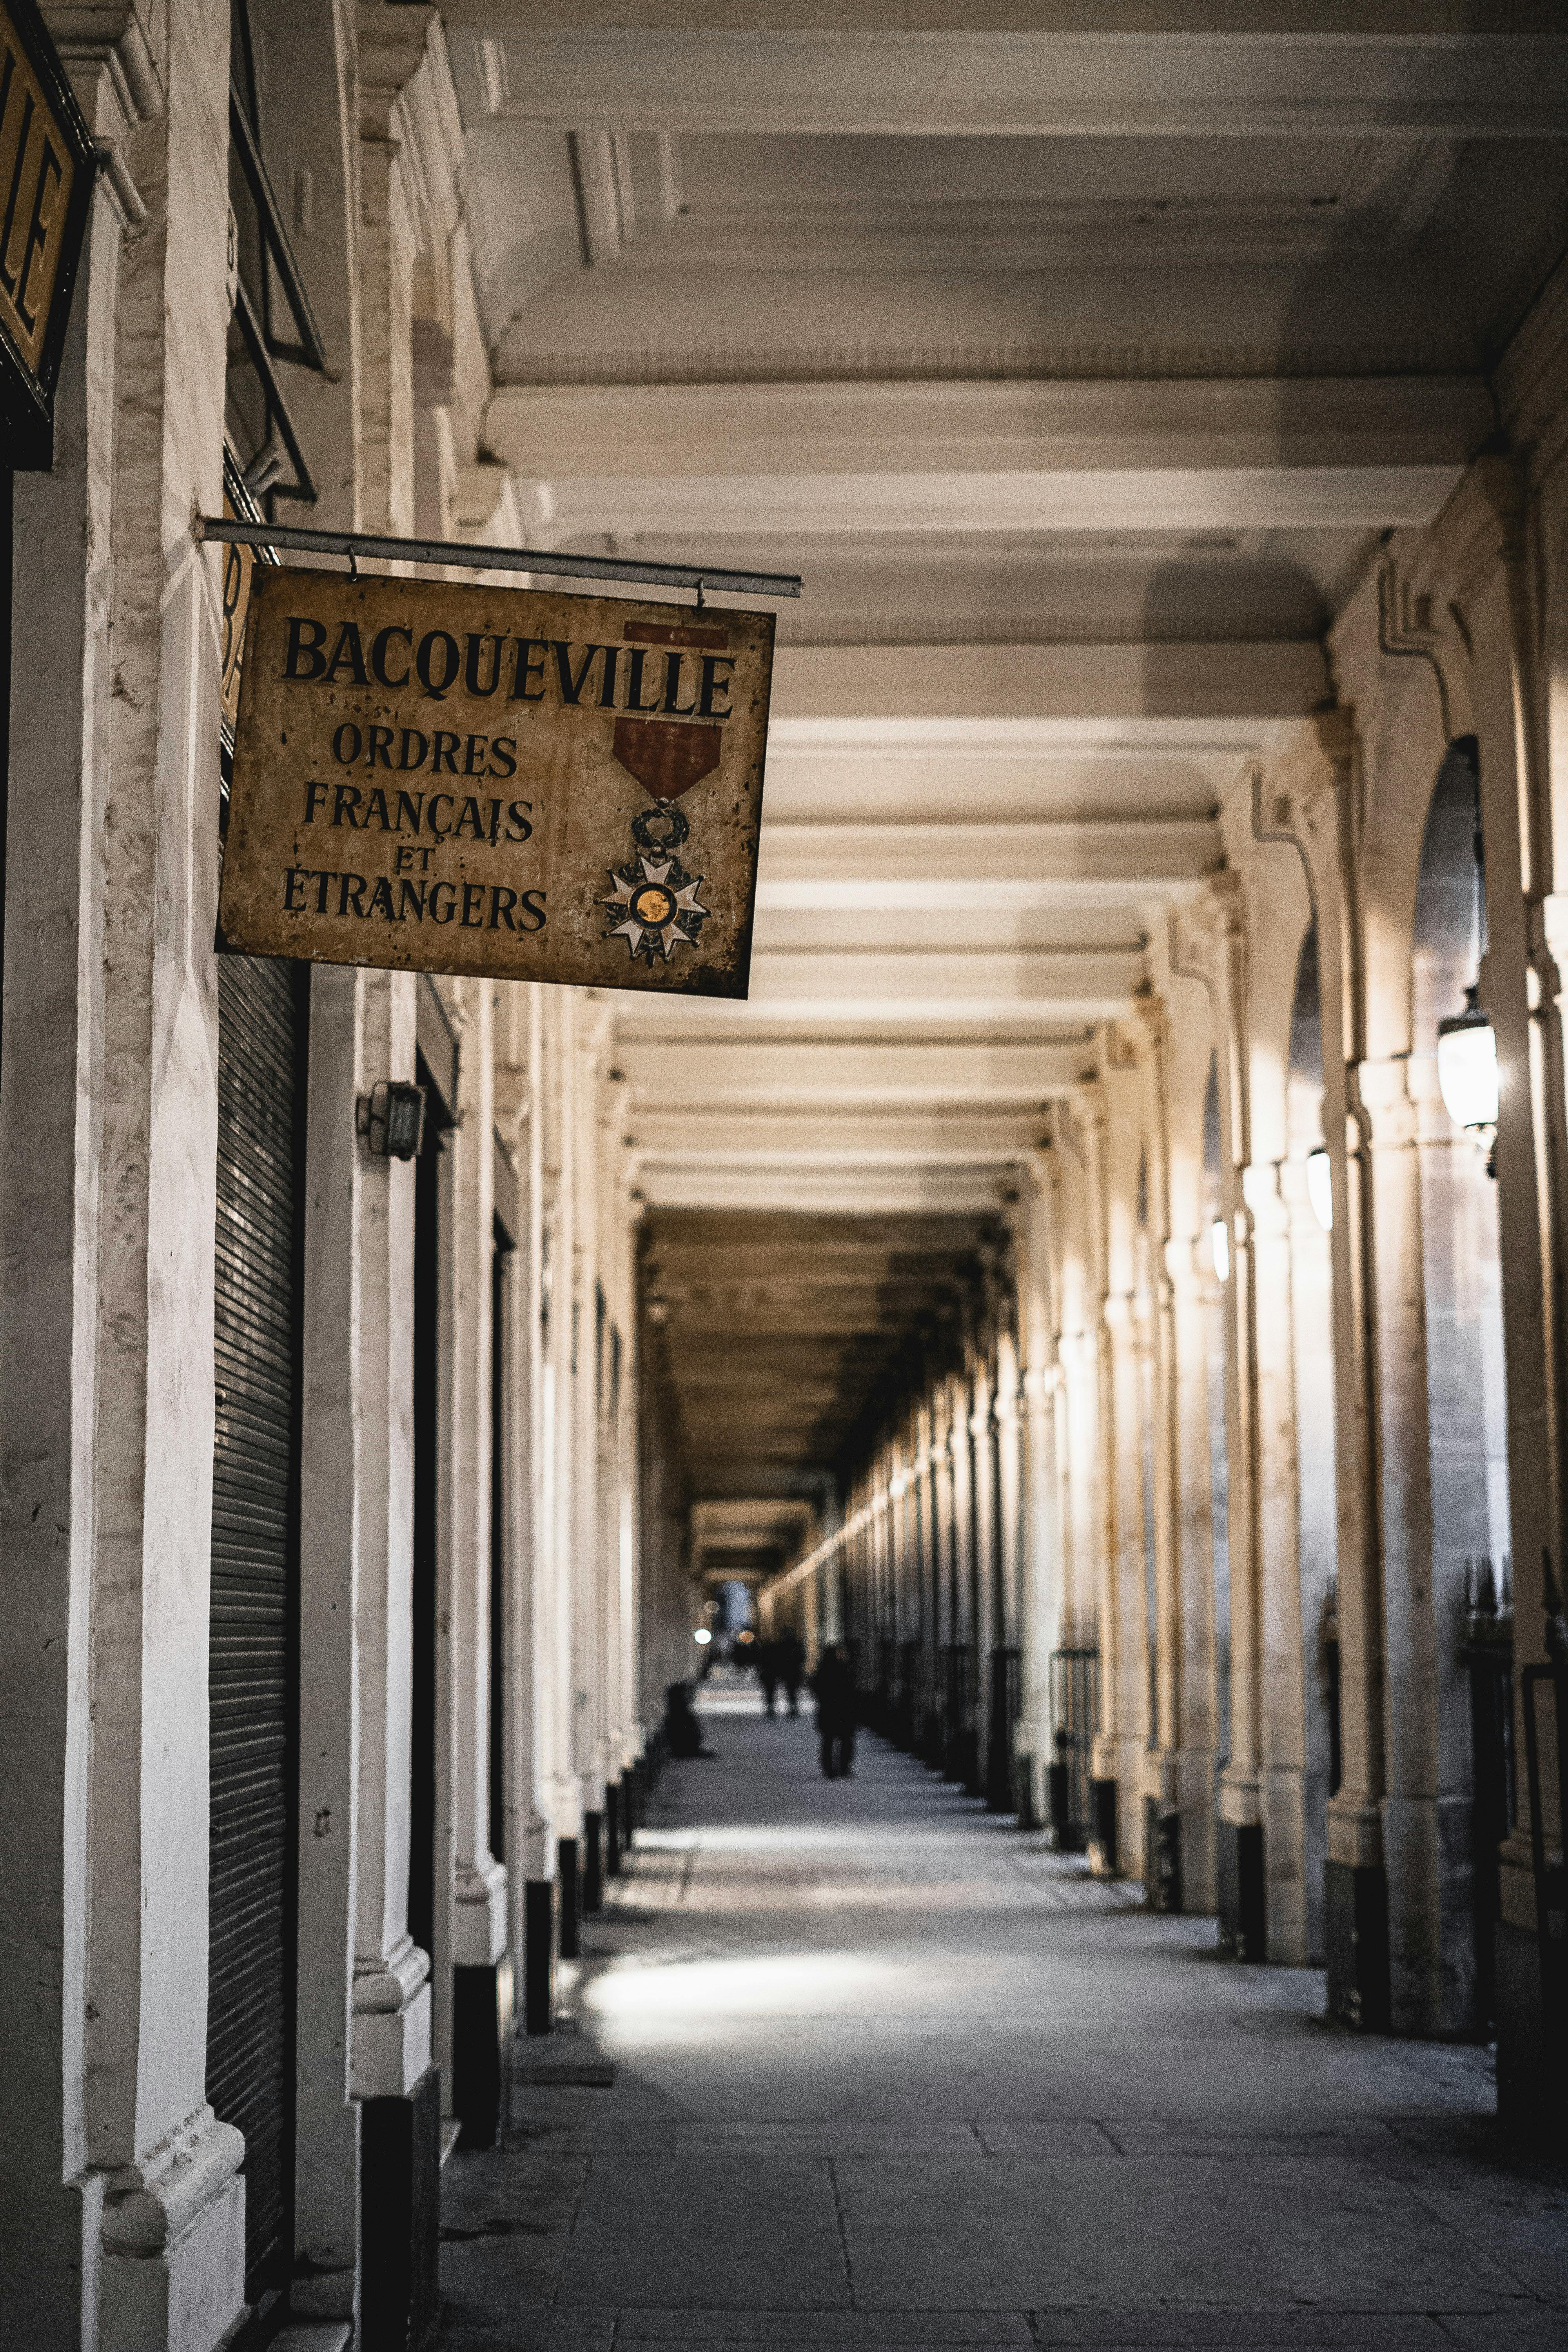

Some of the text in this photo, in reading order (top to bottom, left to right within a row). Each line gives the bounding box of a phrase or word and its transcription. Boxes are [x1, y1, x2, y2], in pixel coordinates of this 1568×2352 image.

[281, 617, 736, 718] BACQUEVILLE
[332, 723, 517, 778] ORDRES
[304, 781, 533, 844] FRANÇAIS
[396, 846, 436, 871] ET
